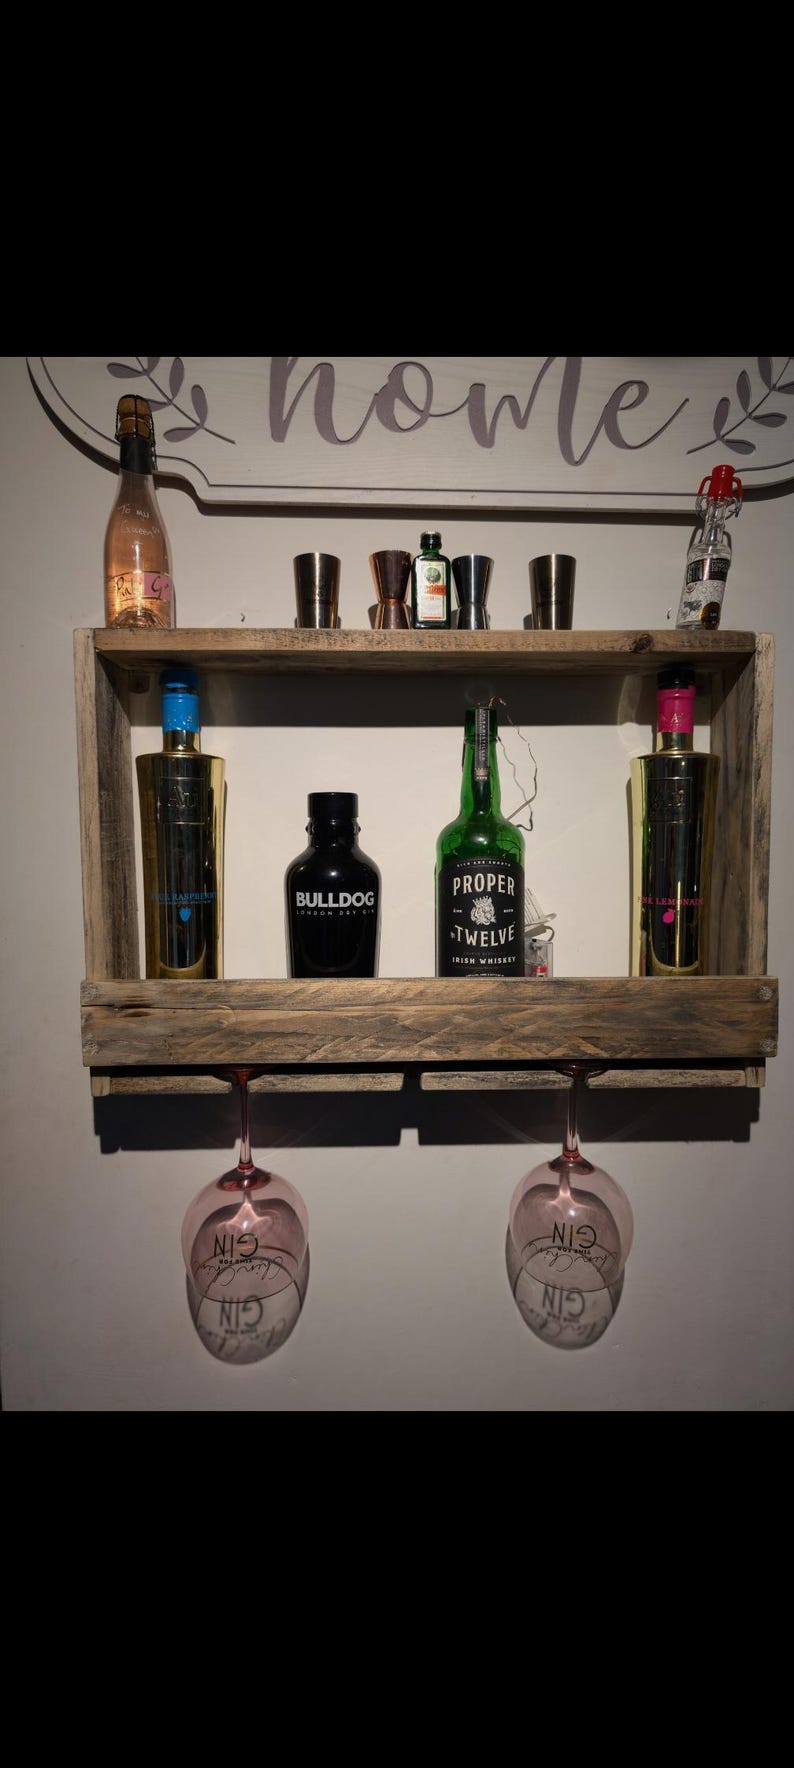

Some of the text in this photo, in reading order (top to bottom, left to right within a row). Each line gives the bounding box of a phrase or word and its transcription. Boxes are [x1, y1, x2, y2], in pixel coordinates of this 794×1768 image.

[269, 357, 689, 466] home
[453, 873, 515, 896] PROPER
[296, 891, 375, 908] BULLDOG
[455, 924, 515, 947] TWELVE
[452, 956, 516, 965] IRISH WHISKEY
[213, 1232, 259, 1258] GIN
[551, 1221, 597, 1249] GIN
